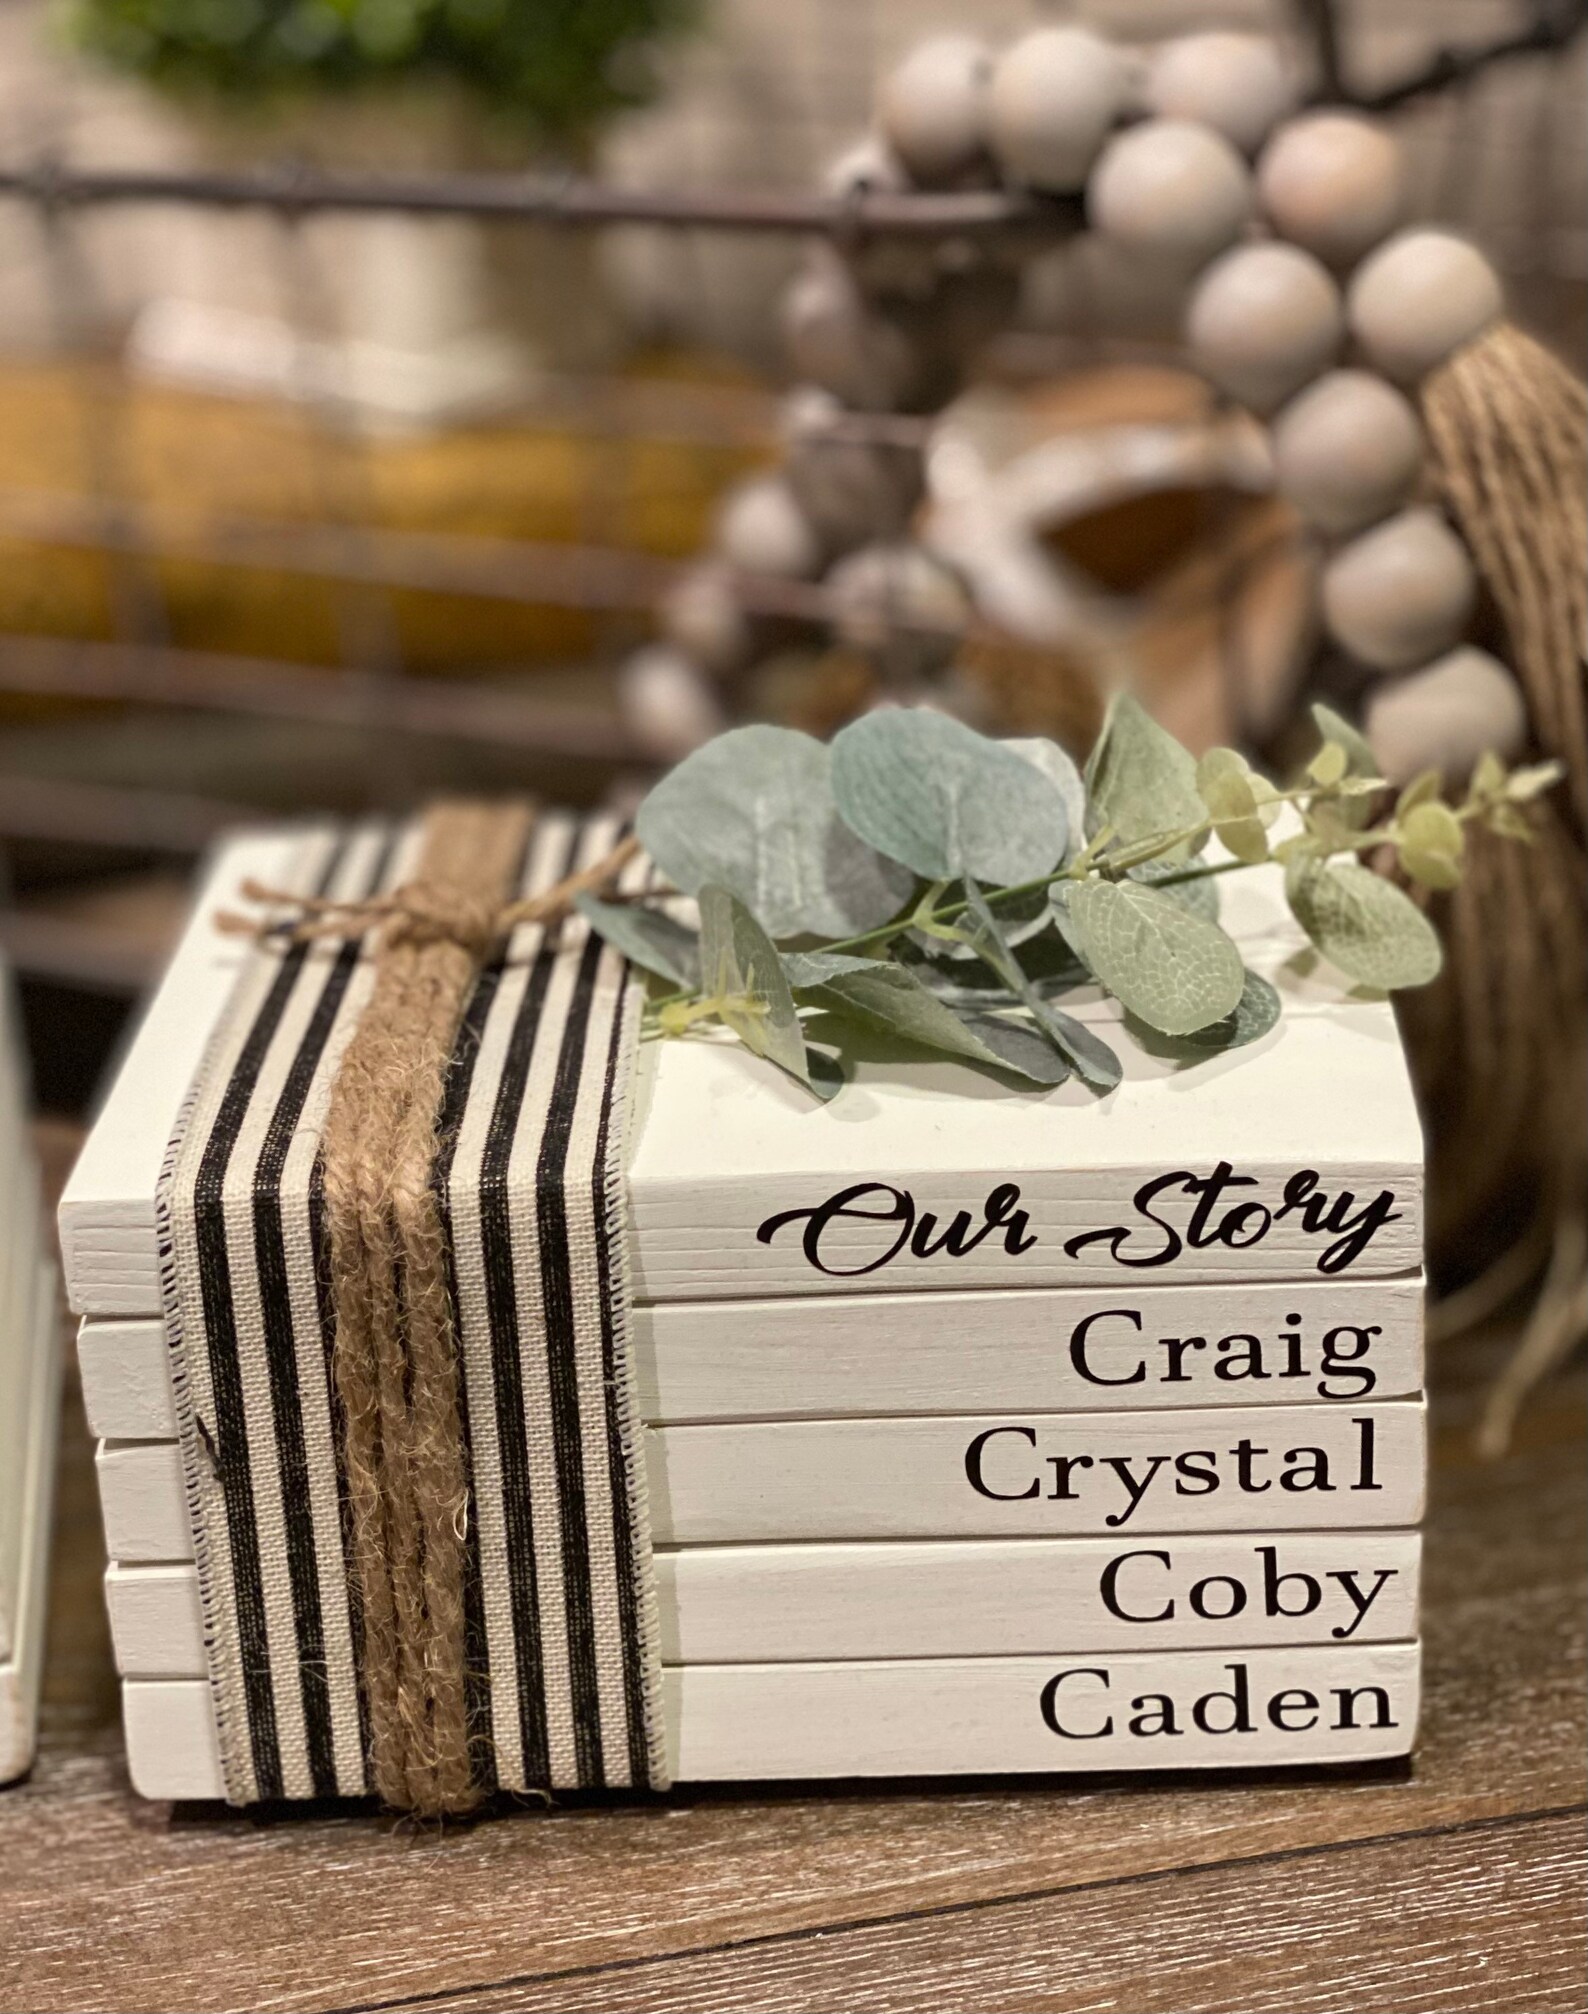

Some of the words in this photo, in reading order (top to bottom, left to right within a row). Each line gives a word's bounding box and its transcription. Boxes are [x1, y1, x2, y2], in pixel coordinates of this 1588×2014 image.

[757, 1183, 1038, 1277] Our
[1063, 1161, 1403, 1275] Story
[1069, 1309, 1383, 1400] Craig
[964, 1417, 1383, 1527] Crystal
[1099, 1546, 1399, 1639] Coby
[1039, 1663, 1399, 1740] Caden
